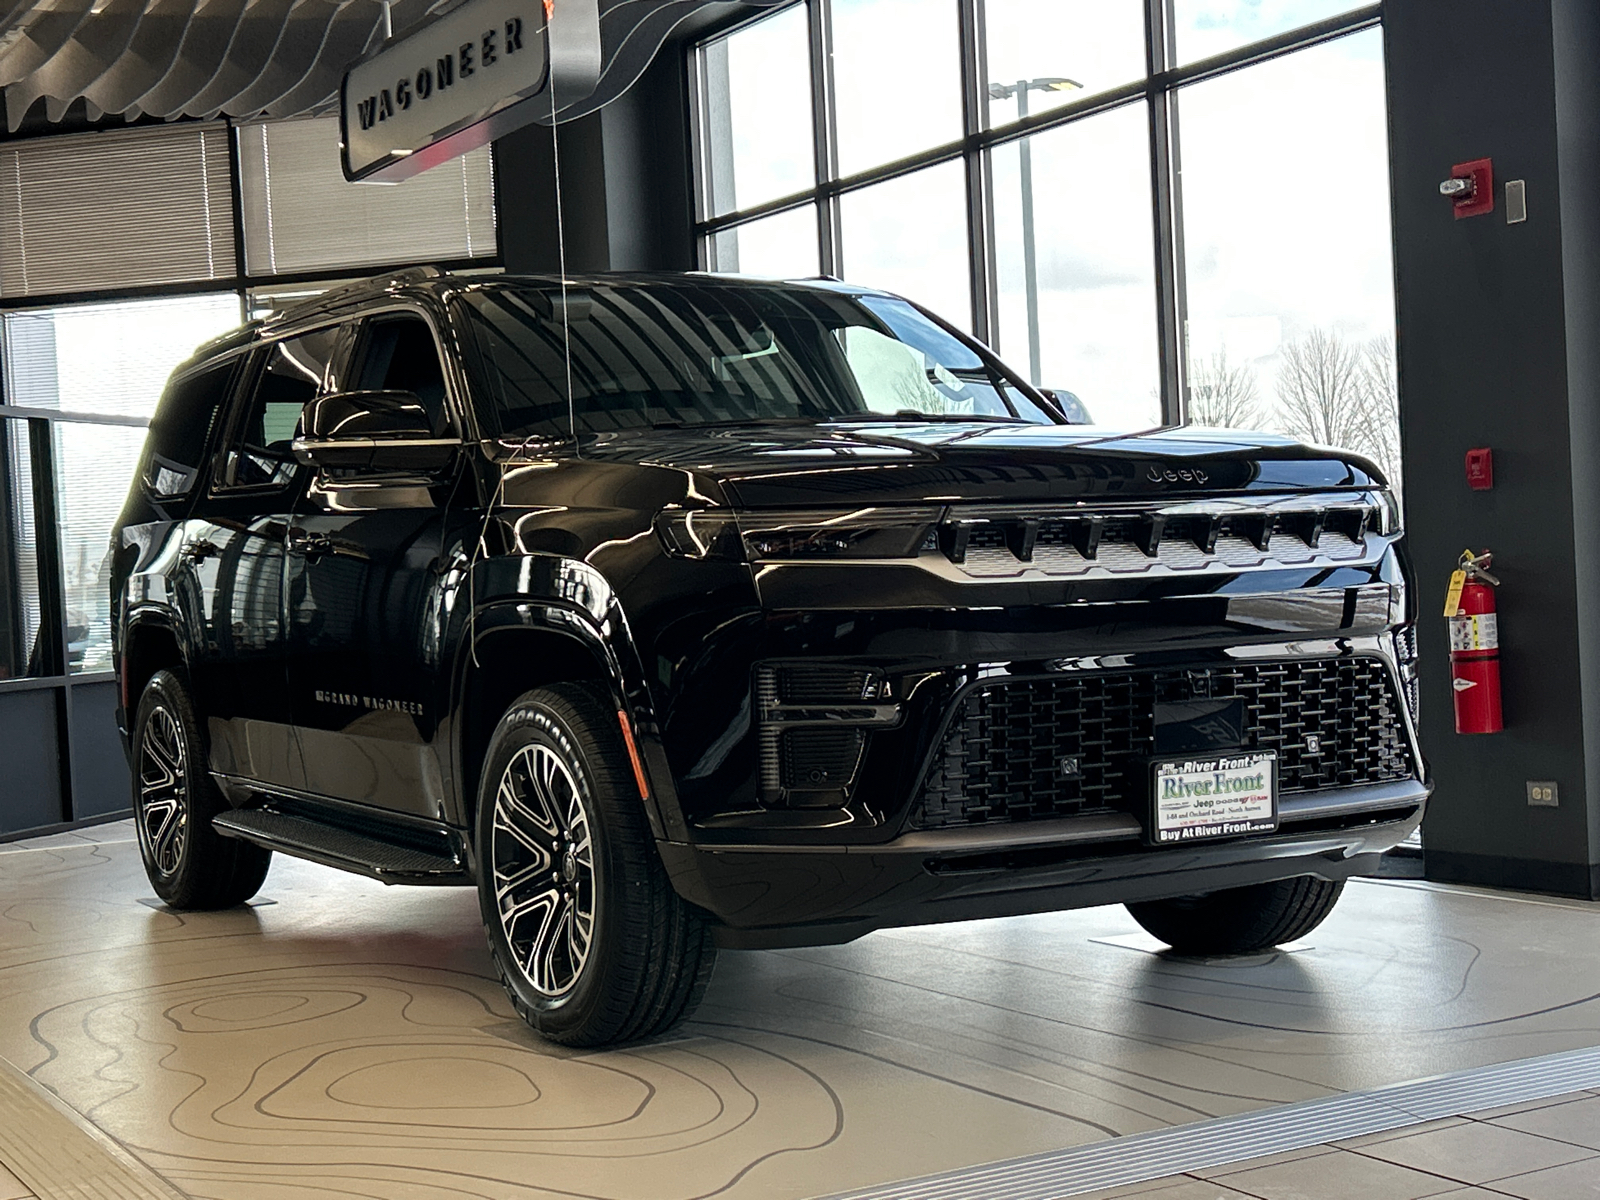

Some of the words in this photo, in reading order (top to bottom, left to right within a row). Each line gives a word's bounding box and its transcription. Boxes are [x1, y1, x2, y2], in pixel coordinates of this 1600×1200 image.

[357, 17, 522, 130] WAGONEER
[1147, 466, 1208, 484] Jeep
[324, 691, 358, 706] GRAND
[363, 696, 423, 716] WAGONEER
[1184, 761, 1216, 773] River
[1219, 757, 1248, 770] Front
[1193, 800, 1214, 808] Jeep
[1161, 830, 1180, 840] Buy
[1182, 828, 1193, 838] At
[1195, 826, 1221, 836] River
[1223, 821, 1274, 833] Front.com
